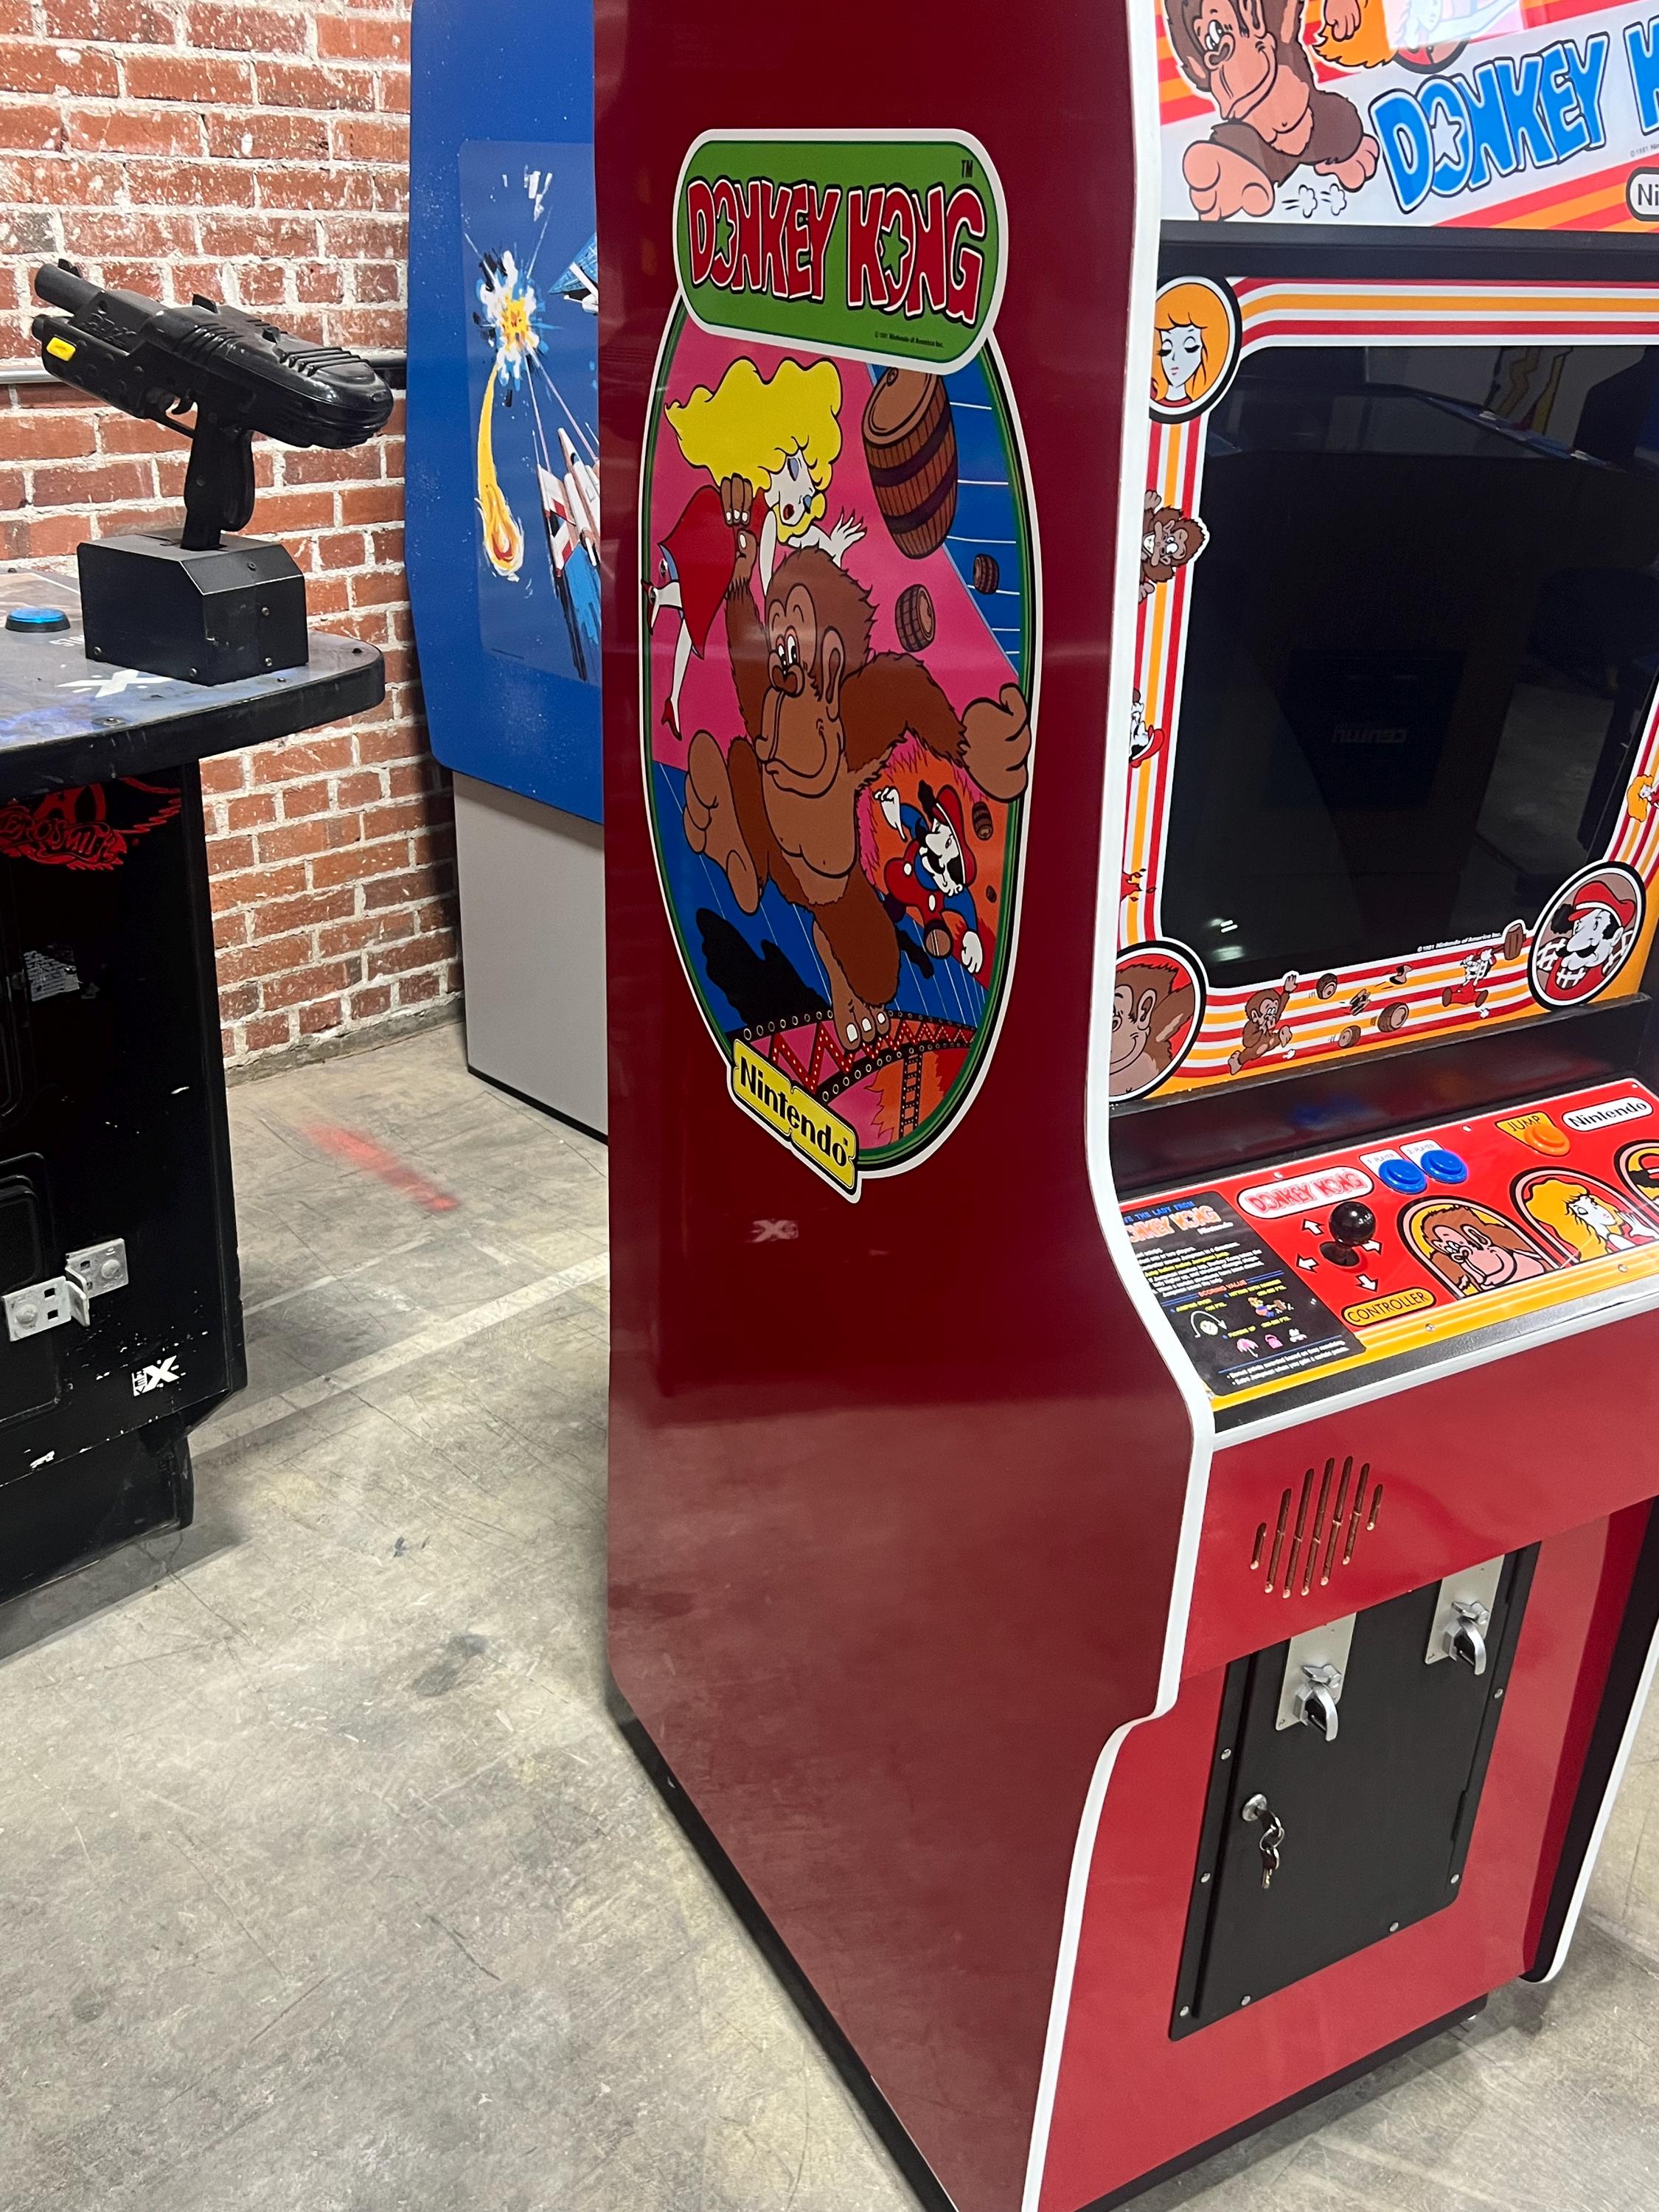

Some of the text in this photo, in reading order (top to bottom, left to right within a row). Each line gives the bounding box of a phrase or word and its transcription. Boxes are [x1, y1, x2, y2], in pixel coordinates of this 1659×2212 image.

[1368, 32, 1610, 215] DONKEY
[961, 159, 973, 178] TM
[686, 175, 987, 327] DONKEY KONG
[740, 1056, 847, 1167] Nintendo
[1508, 1116, 1541, 1133] JUMP
[1568, 1102, 1648, 1127] Nintendo
[1245, 1171, 1368, 1213] DONKEY KONG
[1125, 1205, 1222, 1244] ONKEY KONG
[1152, 1206, 1172, 1217] LADY
[1347, 1291, 1429, 1323] CONTROLLER
